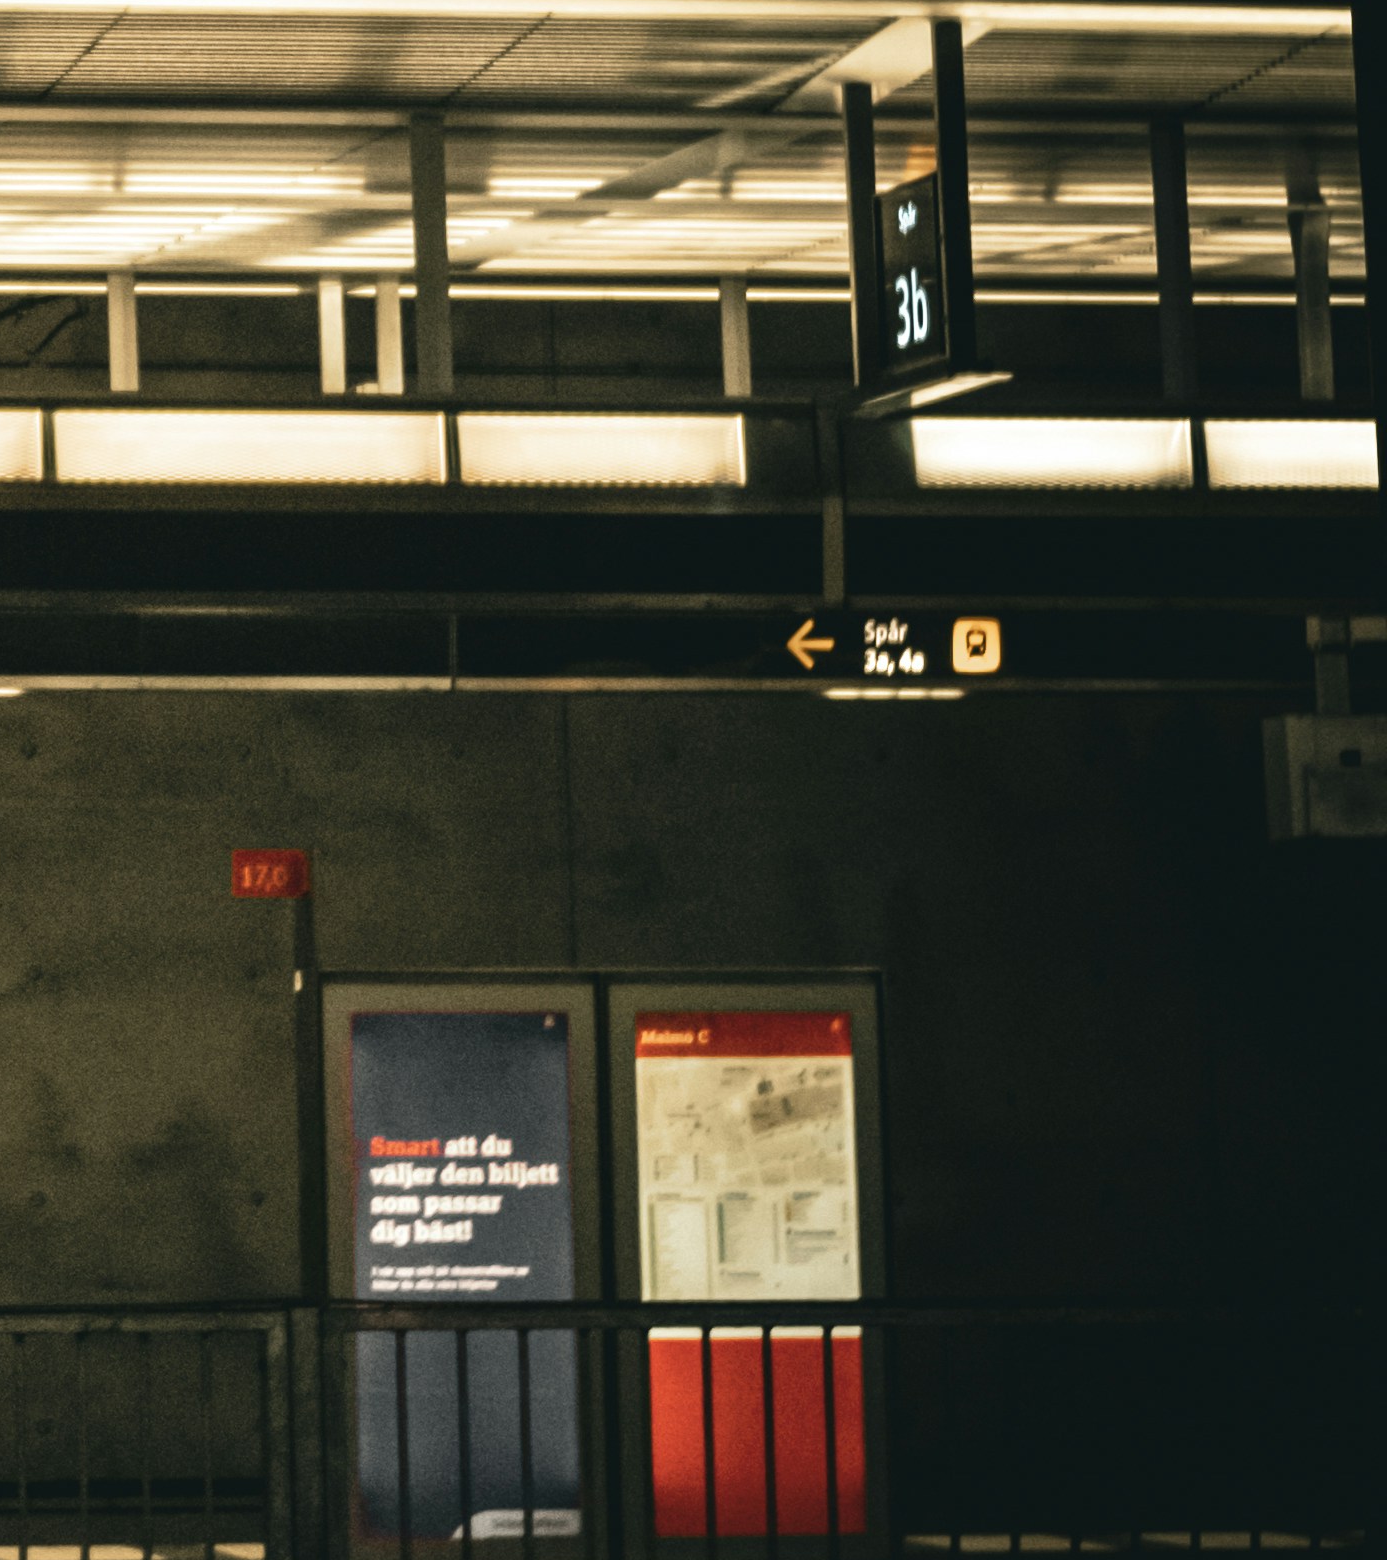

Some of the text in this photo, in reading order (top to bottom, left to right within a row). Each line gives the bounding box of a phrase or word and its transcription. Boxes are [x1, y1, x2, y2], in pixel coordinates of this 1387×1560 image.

[895, 267, 930, 349] 3b
[863, 617, 909, 647] Spår
[370, 1134, 512, 1157] Smart att du
[370, 1162, 559, 1190] väljer den biljett
[370, 1195, 504, 1219] som passar
[370, 1219, 473, 1247] dig bäst!
